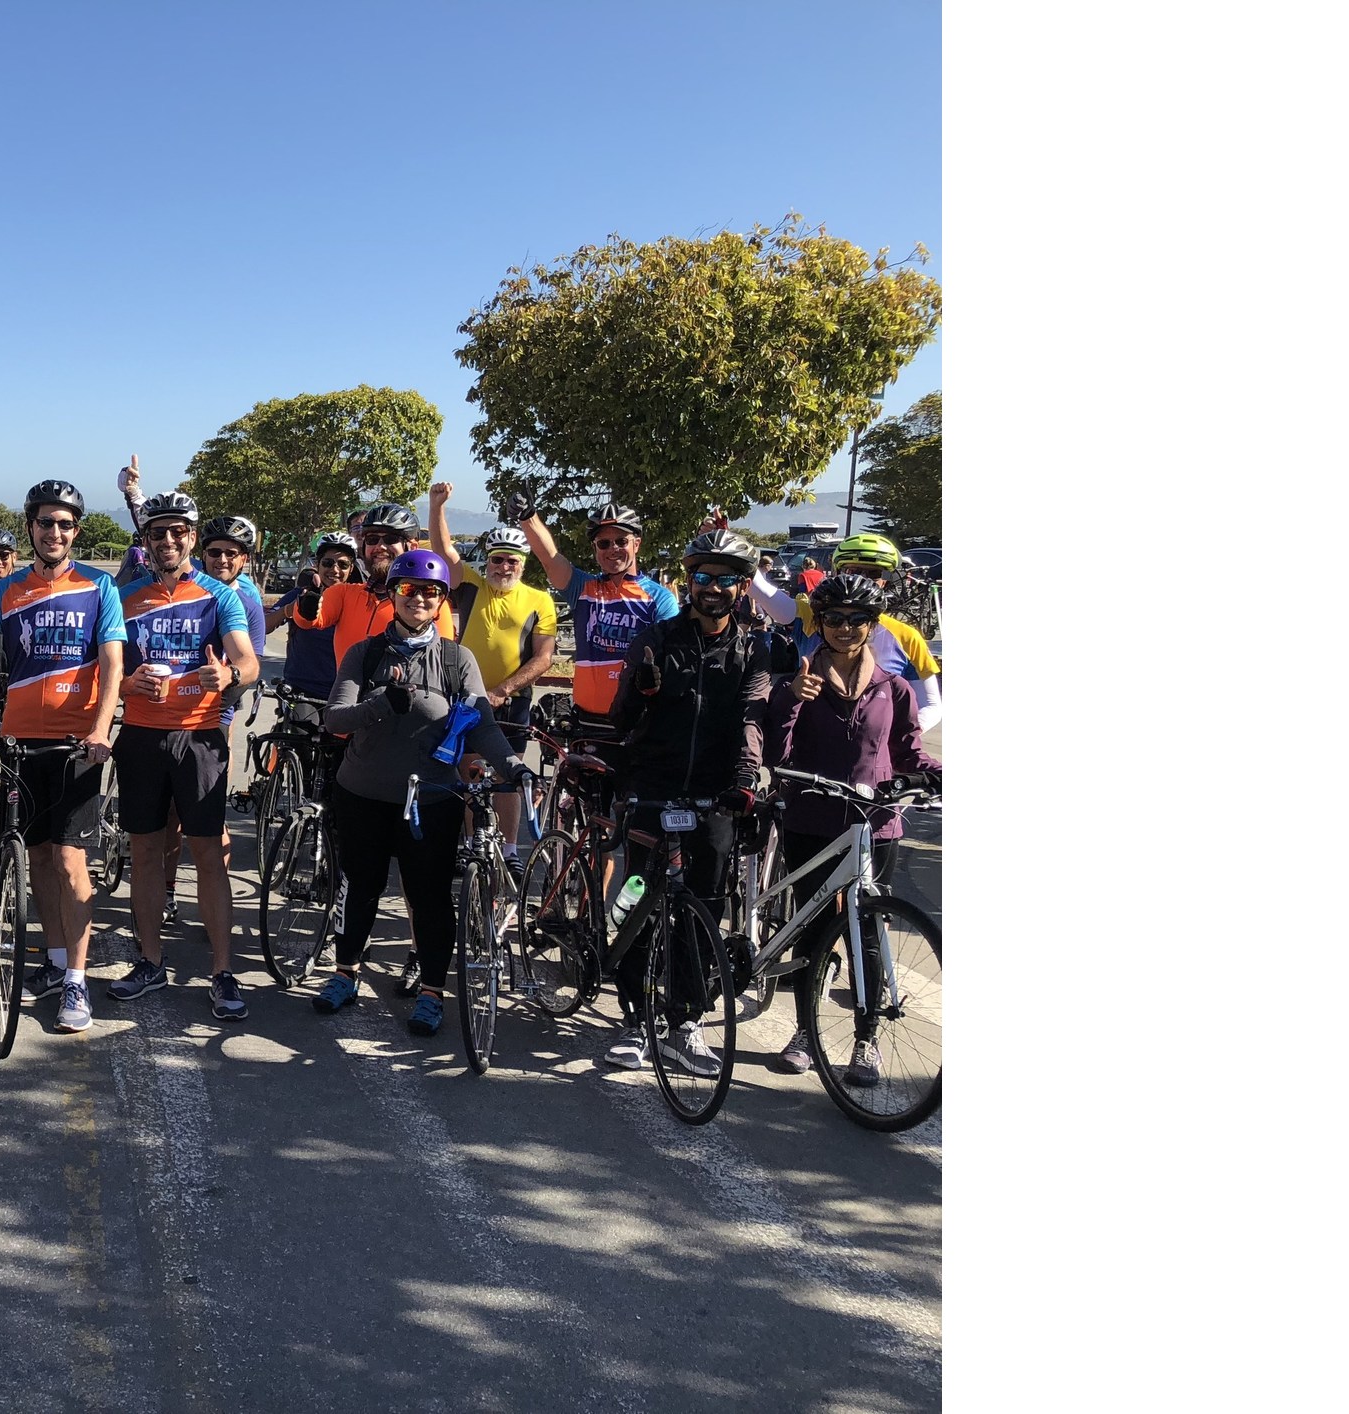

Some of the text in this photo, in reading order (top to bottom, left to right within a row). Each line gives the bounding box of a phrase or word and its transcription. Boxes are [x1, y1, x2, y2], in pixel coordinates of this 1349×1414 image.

[35, 611, 86, 628] GREAT
[152, 618, 202, 633] GREAT
[598, 609, 638, 628] GREAT
[34, 627, 85, 645] CYCLE
[151, 633, 201, 650] CYCLE
[34, 645, 83, 655] CHALLENGE
[149, 650, 200, 659] CHALLENGE
[55, 682, 80, 693] 2018
[177, 685, 201, 696] 2018
